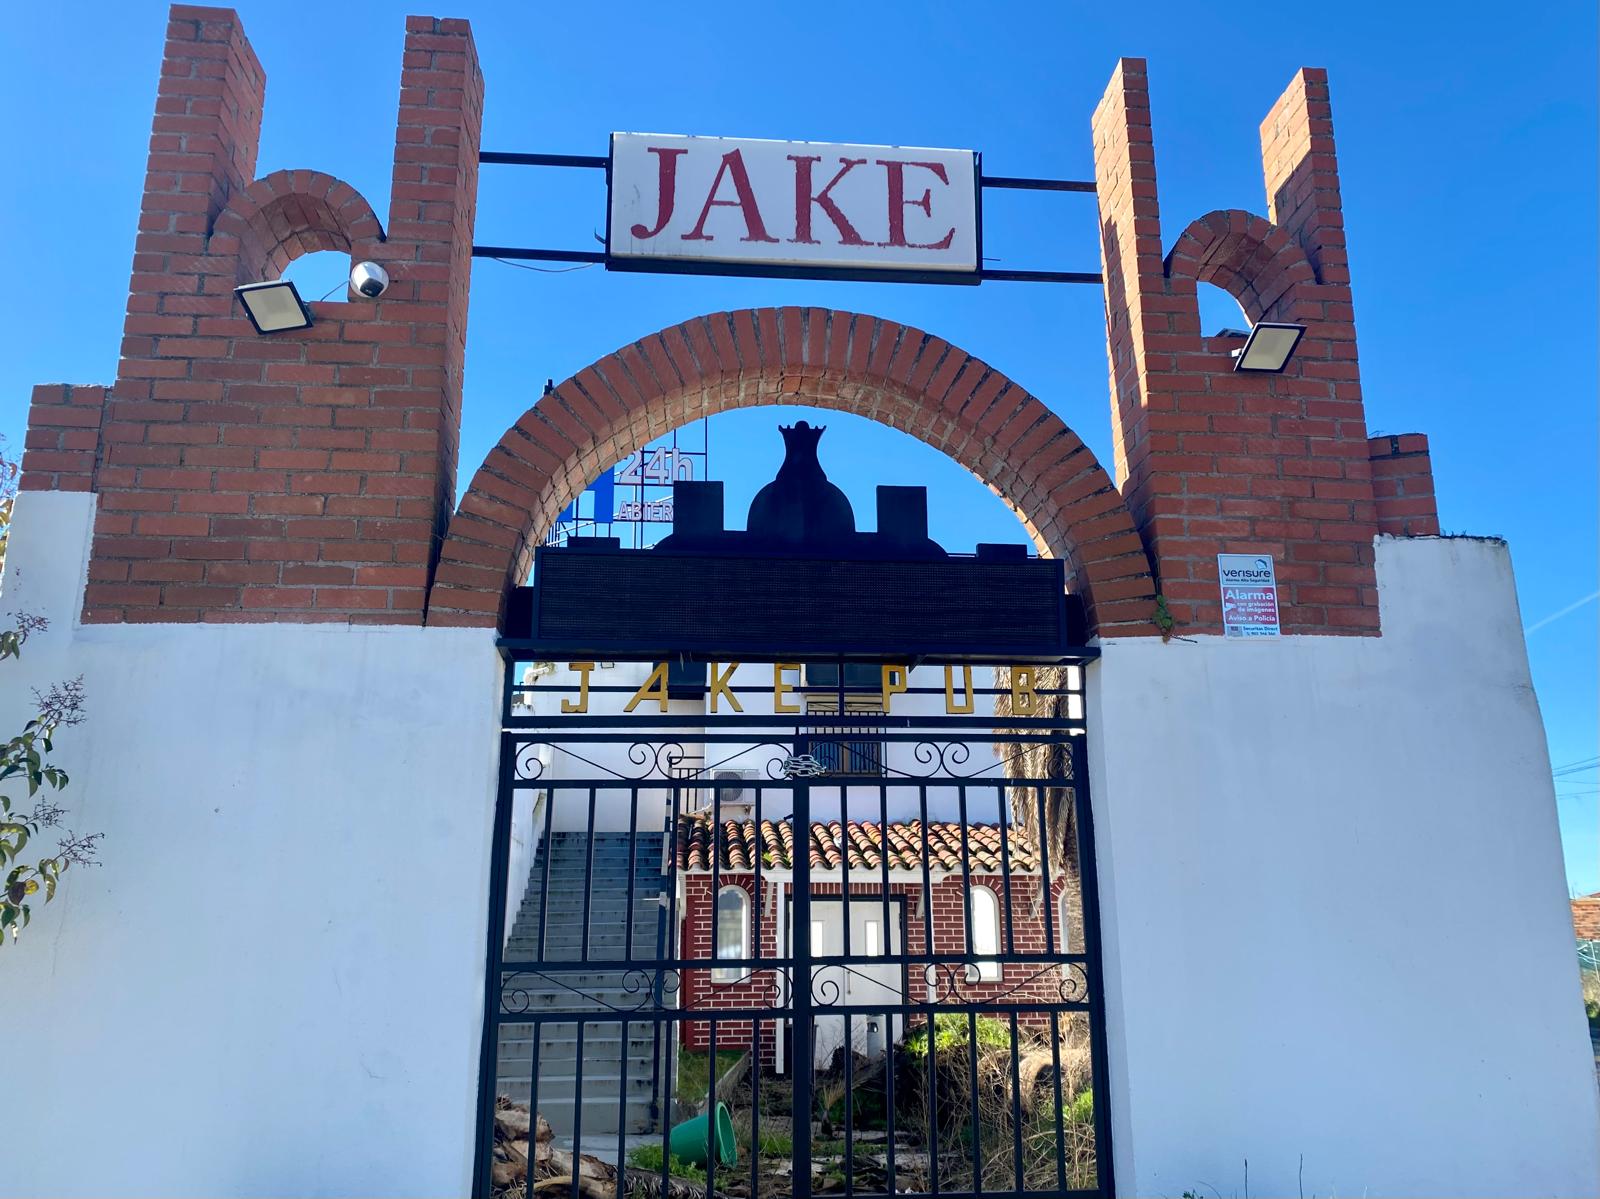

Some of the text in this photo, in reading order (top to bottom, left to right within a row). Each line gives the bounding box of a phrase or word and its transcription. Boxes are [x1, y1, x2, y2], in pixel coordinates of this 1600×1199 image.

[630, 147, 956, 250] JAKE
[618, 446, 694, 486] 24h
[1222, 569, 1271, 578] verisure
[1225, 589, 1274, 600] Alarma
[561, 661, 1037, 715] JAKE PUB
